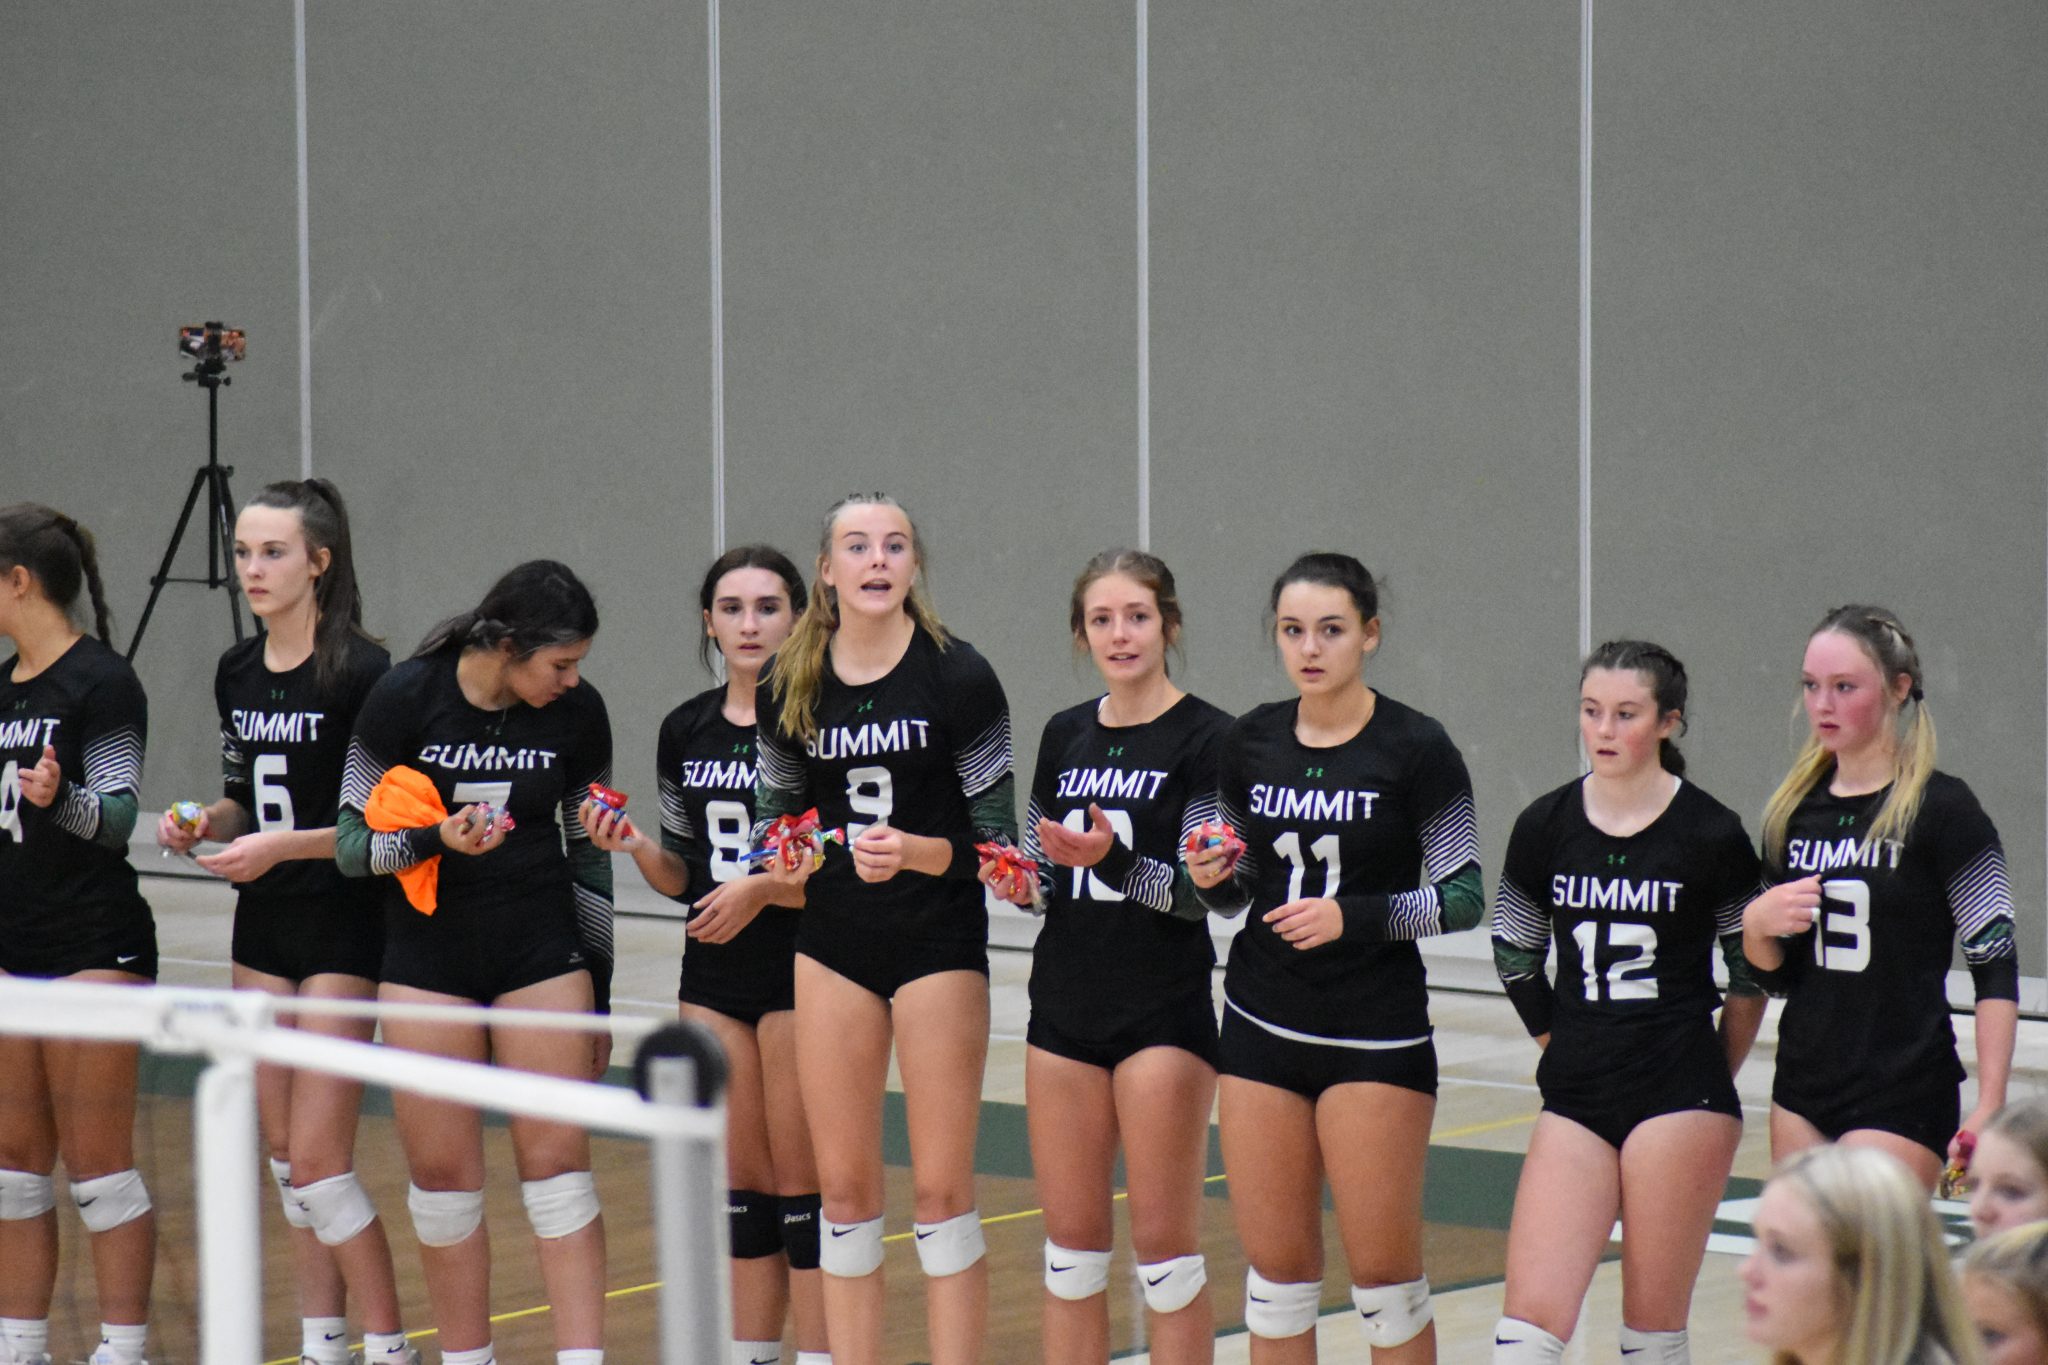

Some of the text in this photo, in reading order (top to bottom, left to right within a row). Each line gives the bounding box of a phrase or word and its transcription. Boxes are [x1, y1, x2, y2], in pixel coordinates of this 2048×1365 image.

[0, 718, 61, 749] MMIT
[231, 709, 324, 742] SUMMIT
[418, 743, 557, 770] SUMMIT
[682, 760, 757, 790] SUMM
[253, 754, 294, 833] 6
[1056, 767, 1169, 800] SUMMIT
[1250, 783, 1380, 822] SUMMIT
[846, 765, 893, 850] 9
[705, 800, 751, 883] 8
[1788, 837, 1905, 873] SUMMIT
[1272, 831, 1341, 901] 11
[1552, 874, 1683, 913] SUMMIT
[1572, 921, 1659, 1002] 12
